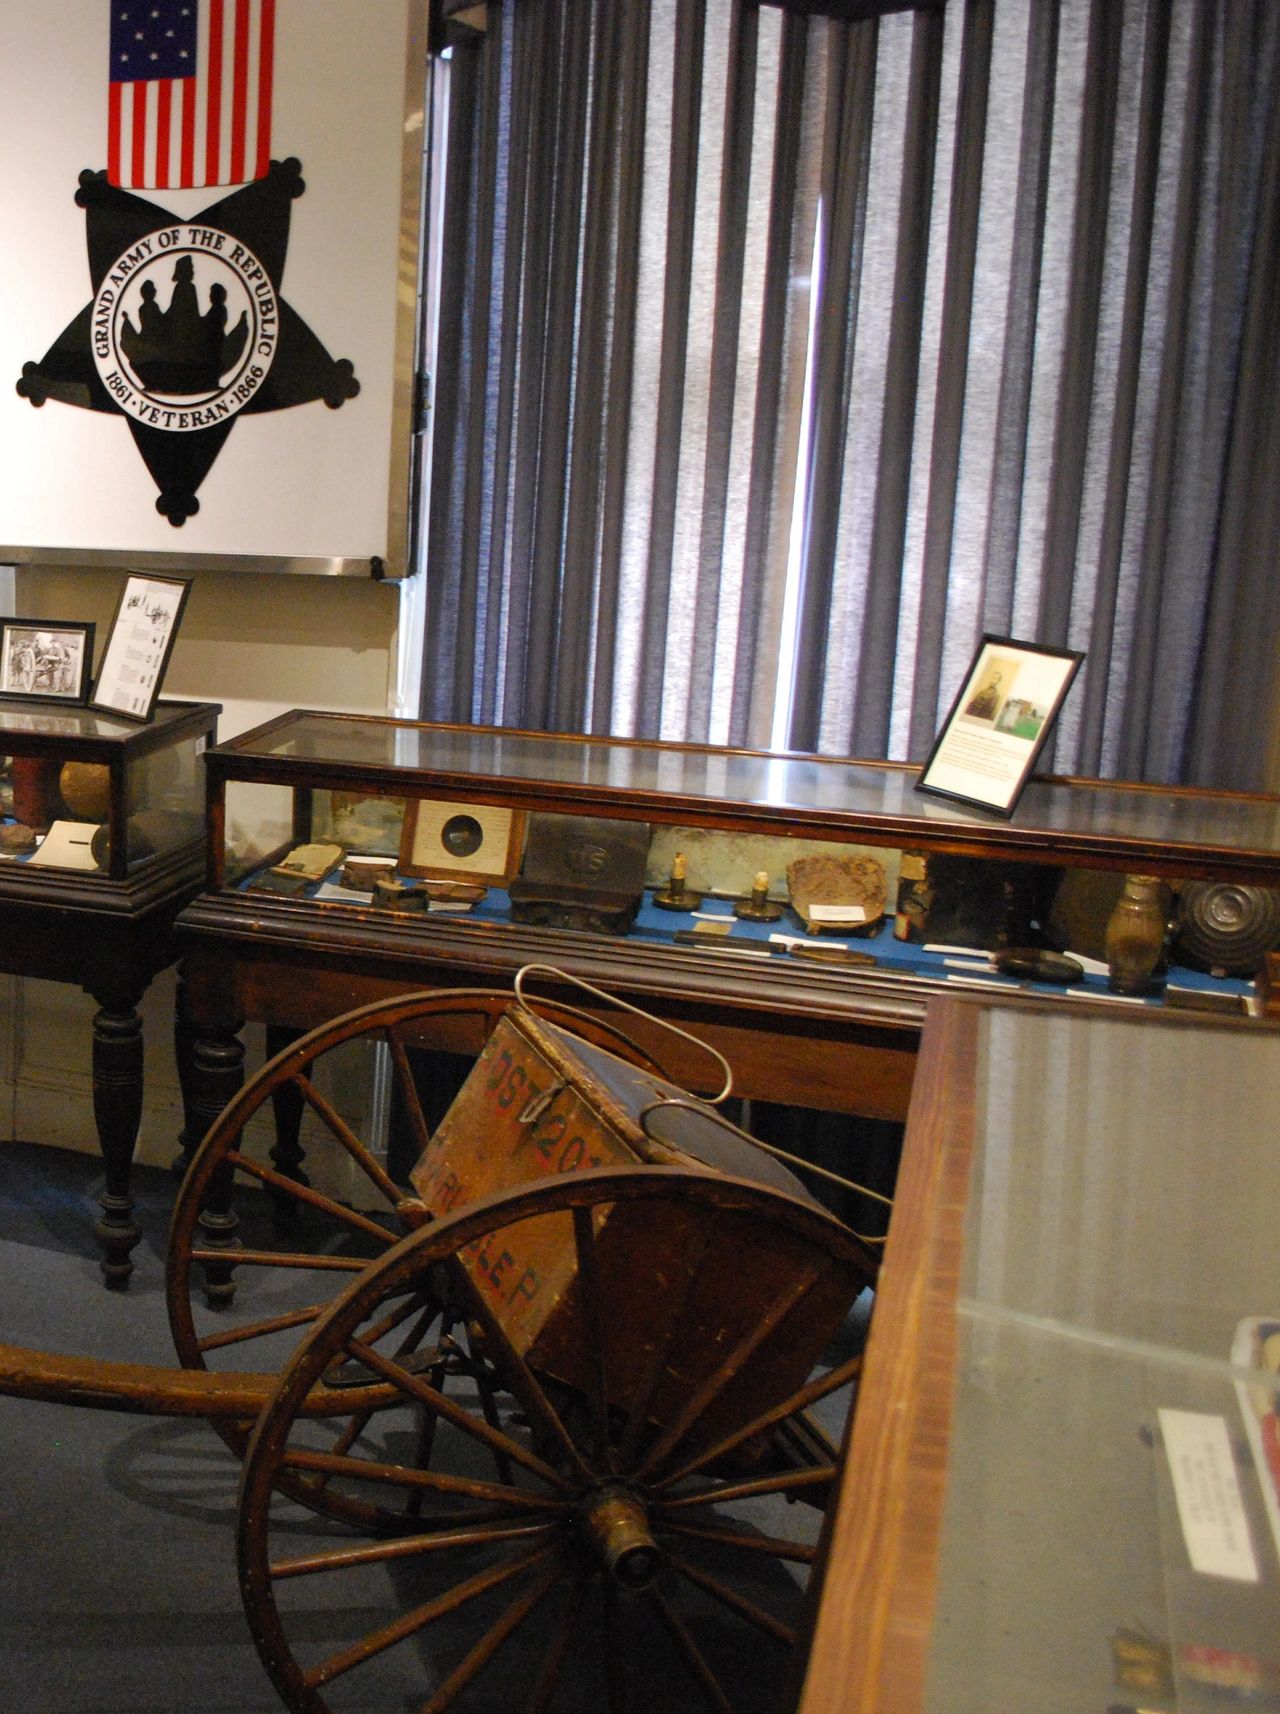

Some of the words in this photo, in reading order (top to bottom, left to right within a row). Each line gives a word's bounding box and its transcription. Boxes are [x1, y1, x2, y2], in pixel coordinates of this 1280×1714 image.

[94, 289, 115, 359] GRAND
[110, 238, 153, 288] ARMY
[158, 229, 180, 248] OF
[188, 228, 226, 251] THE
[229, 243, 276, 357] REPUBLIC
[105, 370, 134, 405] 1861
[138, 399, 230, 428] VETERAN
[231, 364, 264, 405] 1866
